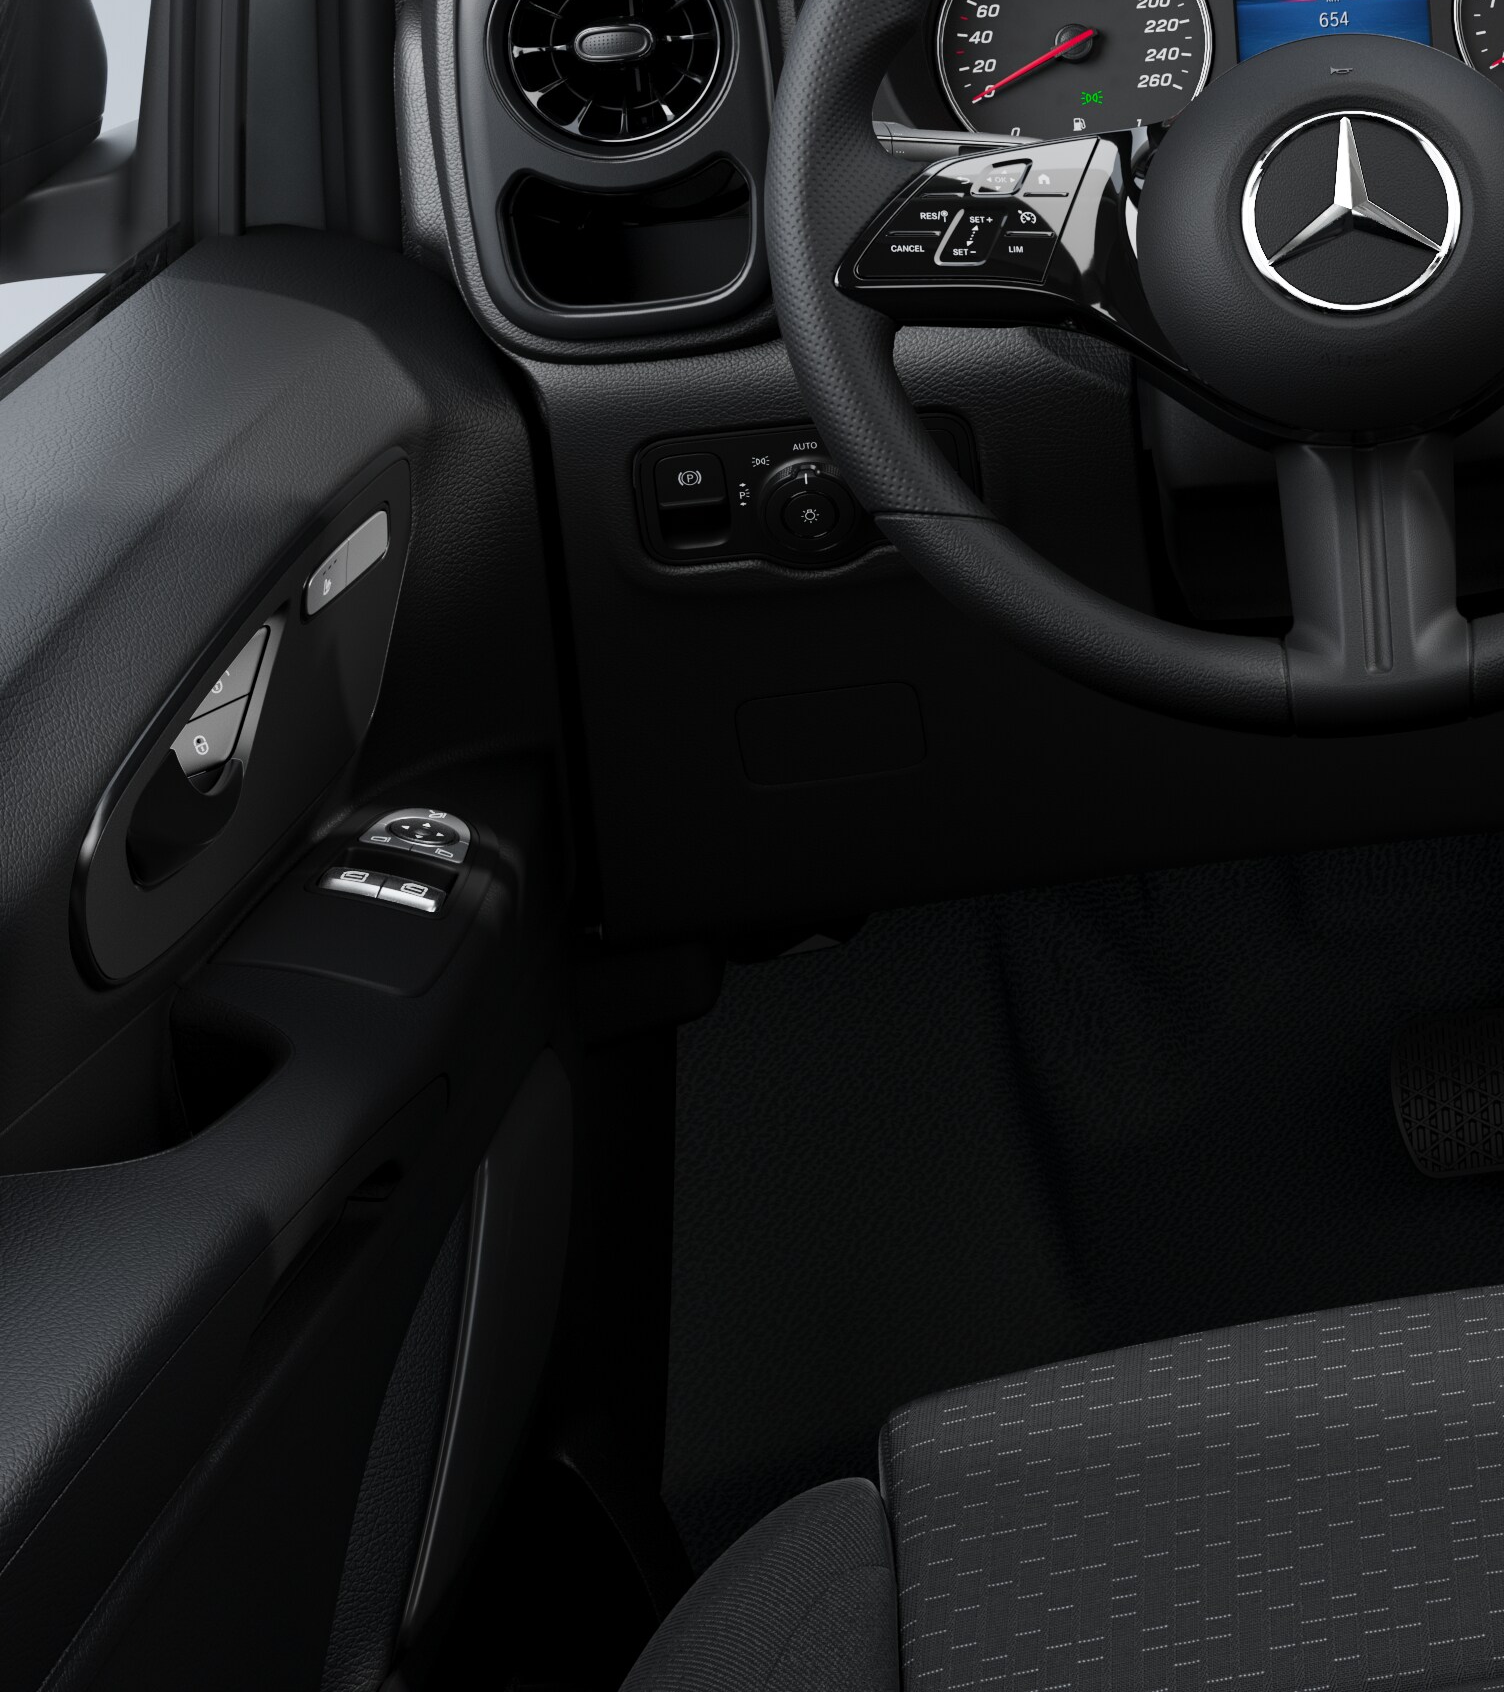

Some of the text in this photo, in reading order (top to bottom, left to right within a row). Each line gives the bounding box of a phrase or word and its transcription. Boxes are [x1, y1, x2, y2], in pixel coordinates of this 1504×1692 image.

[976, 4, 1000, 18] 60
[1144, 19, 1179, 33] 220
[1319, 11, 1350, 28] 654
[969, 30, 993, 44] 40
[1145, 48, 1180, 62] 240
[972, 59, 997, 73] 20
[1138, 74, 1173, 88] 260
[984, 85, 995, 99] 0
[994, 176, 1008, 184] OK
[891, 245, 925, 253] CANCEL
[1008, 246, 1024, 254] LIM
[793, 442, 818, 451] AUTO
